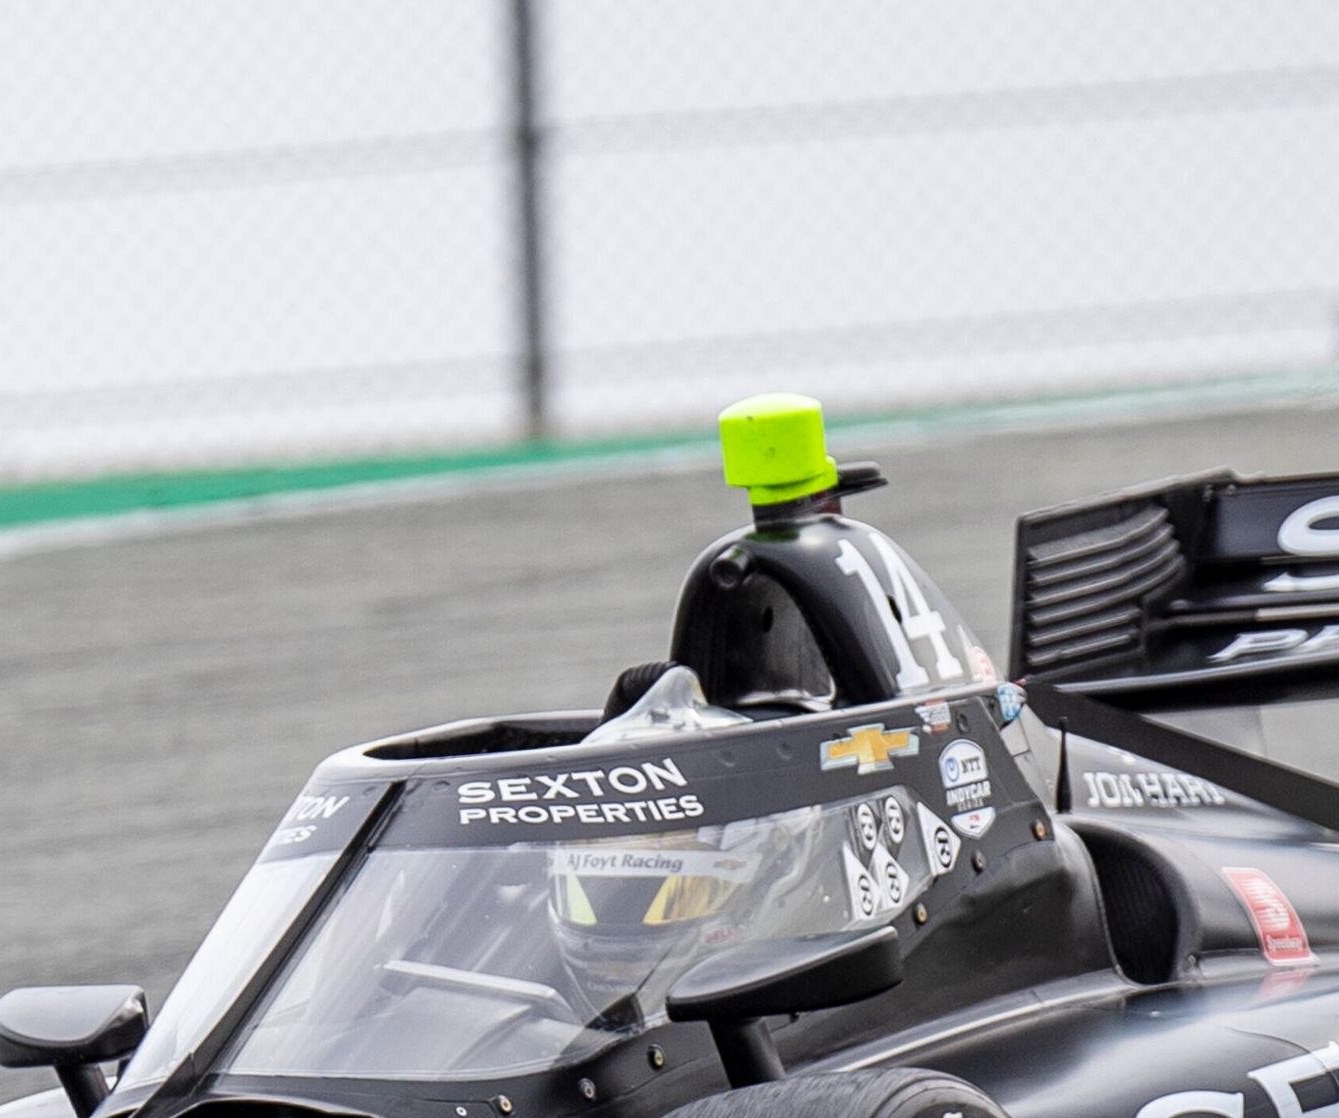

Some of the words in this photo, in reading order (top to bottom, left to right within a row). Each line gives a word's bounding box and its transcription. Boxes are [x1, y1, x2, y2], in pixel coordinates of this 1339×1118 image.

[835, 531, 964, 691] 14
[457, 757, 689, 804] SEXTON
[459, 794, 705, 825] PROPERTIES
[583, 853, 618, 870] Foyt
[620, 853, 685, 873] Racing
